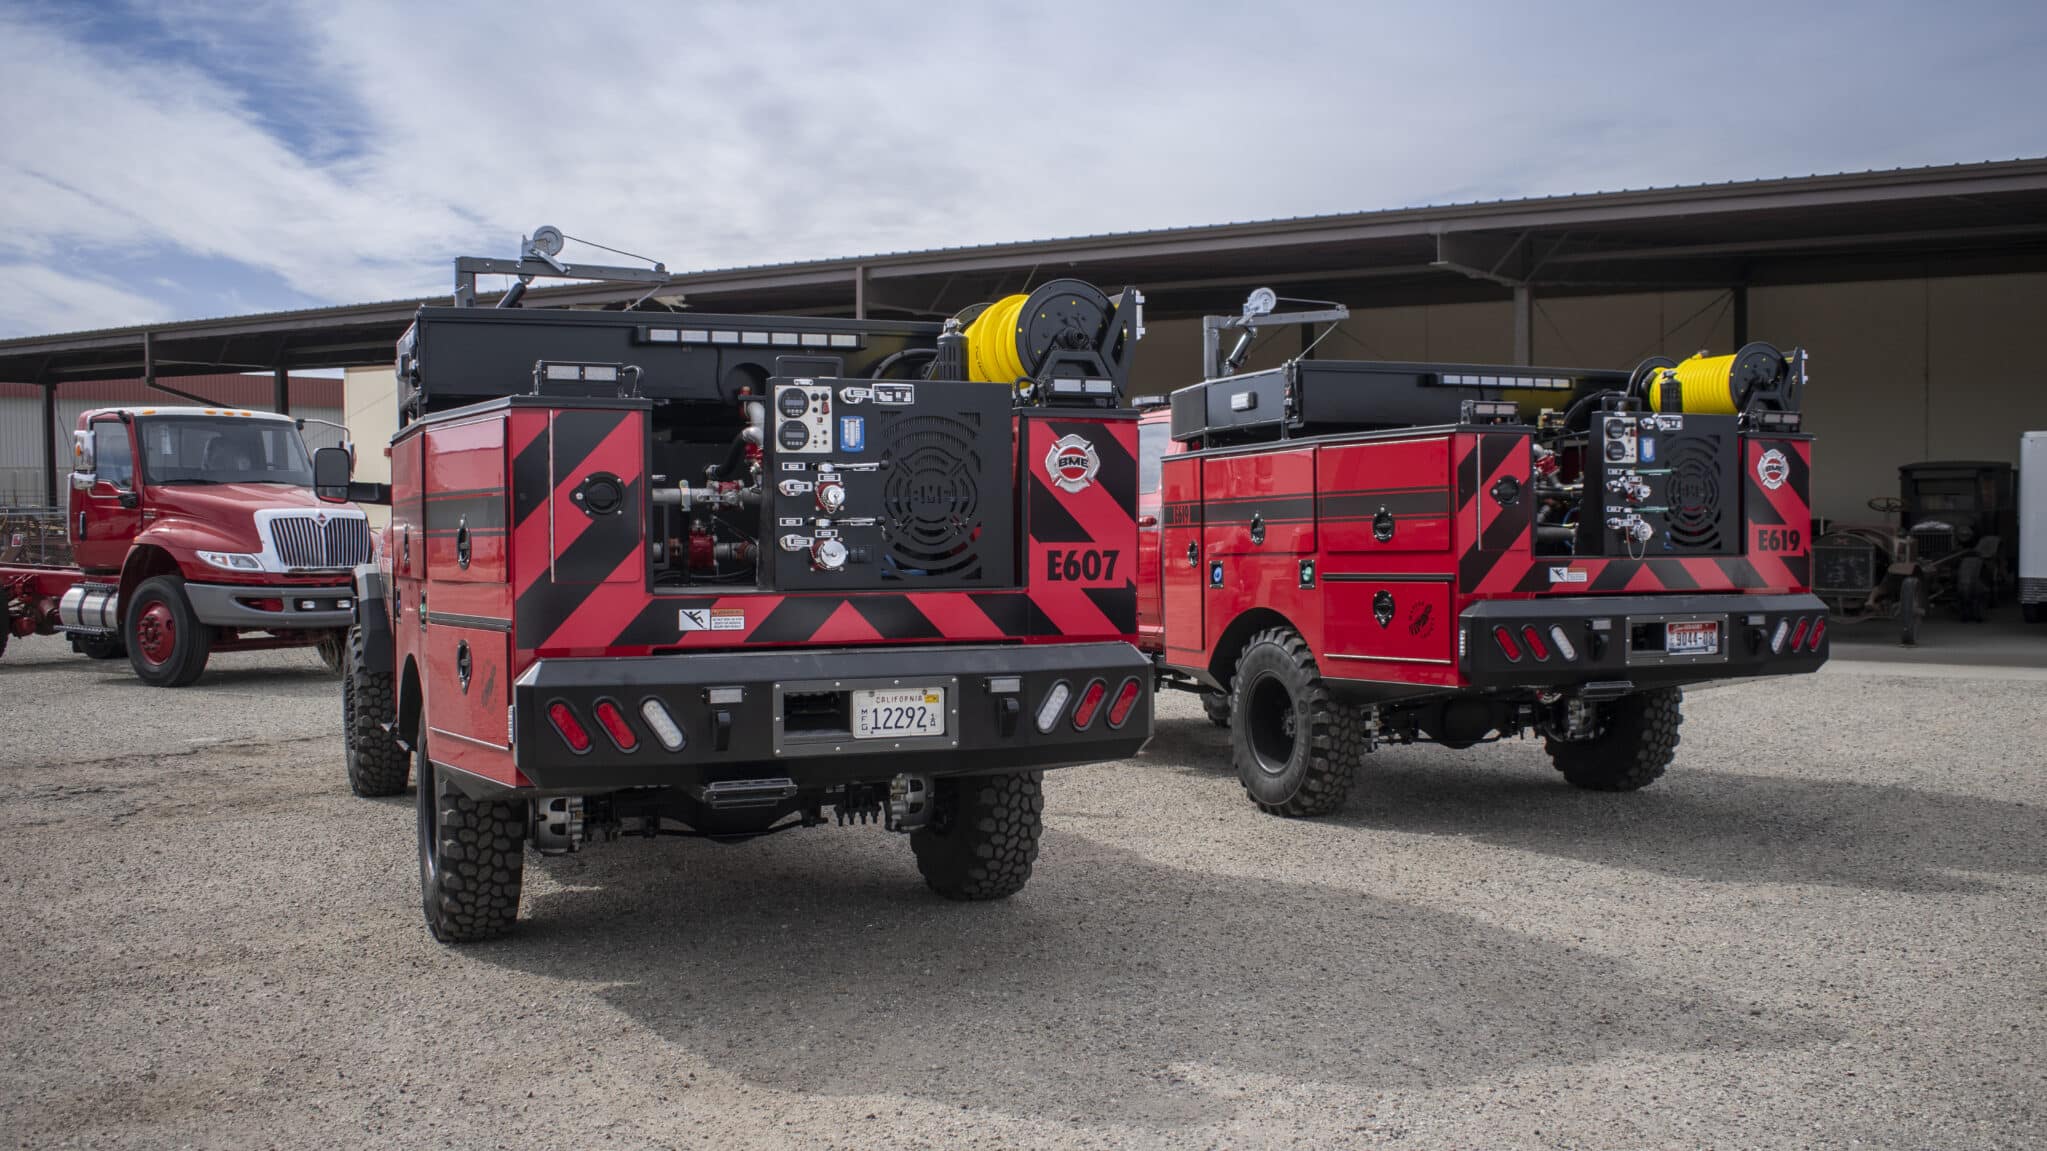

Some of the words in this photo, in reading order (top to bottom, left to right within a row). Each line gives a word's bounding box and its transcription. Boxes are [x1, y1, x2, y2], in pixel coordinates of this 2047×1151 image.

[1059, 456, 1089, 468] BME
[1758, 529, 1801, 551] E619
[1047, 550, 1121, 582] E607
[876, 694, 924, 704] CALIFORNIA
[872, 706, 927, 730] 12292
